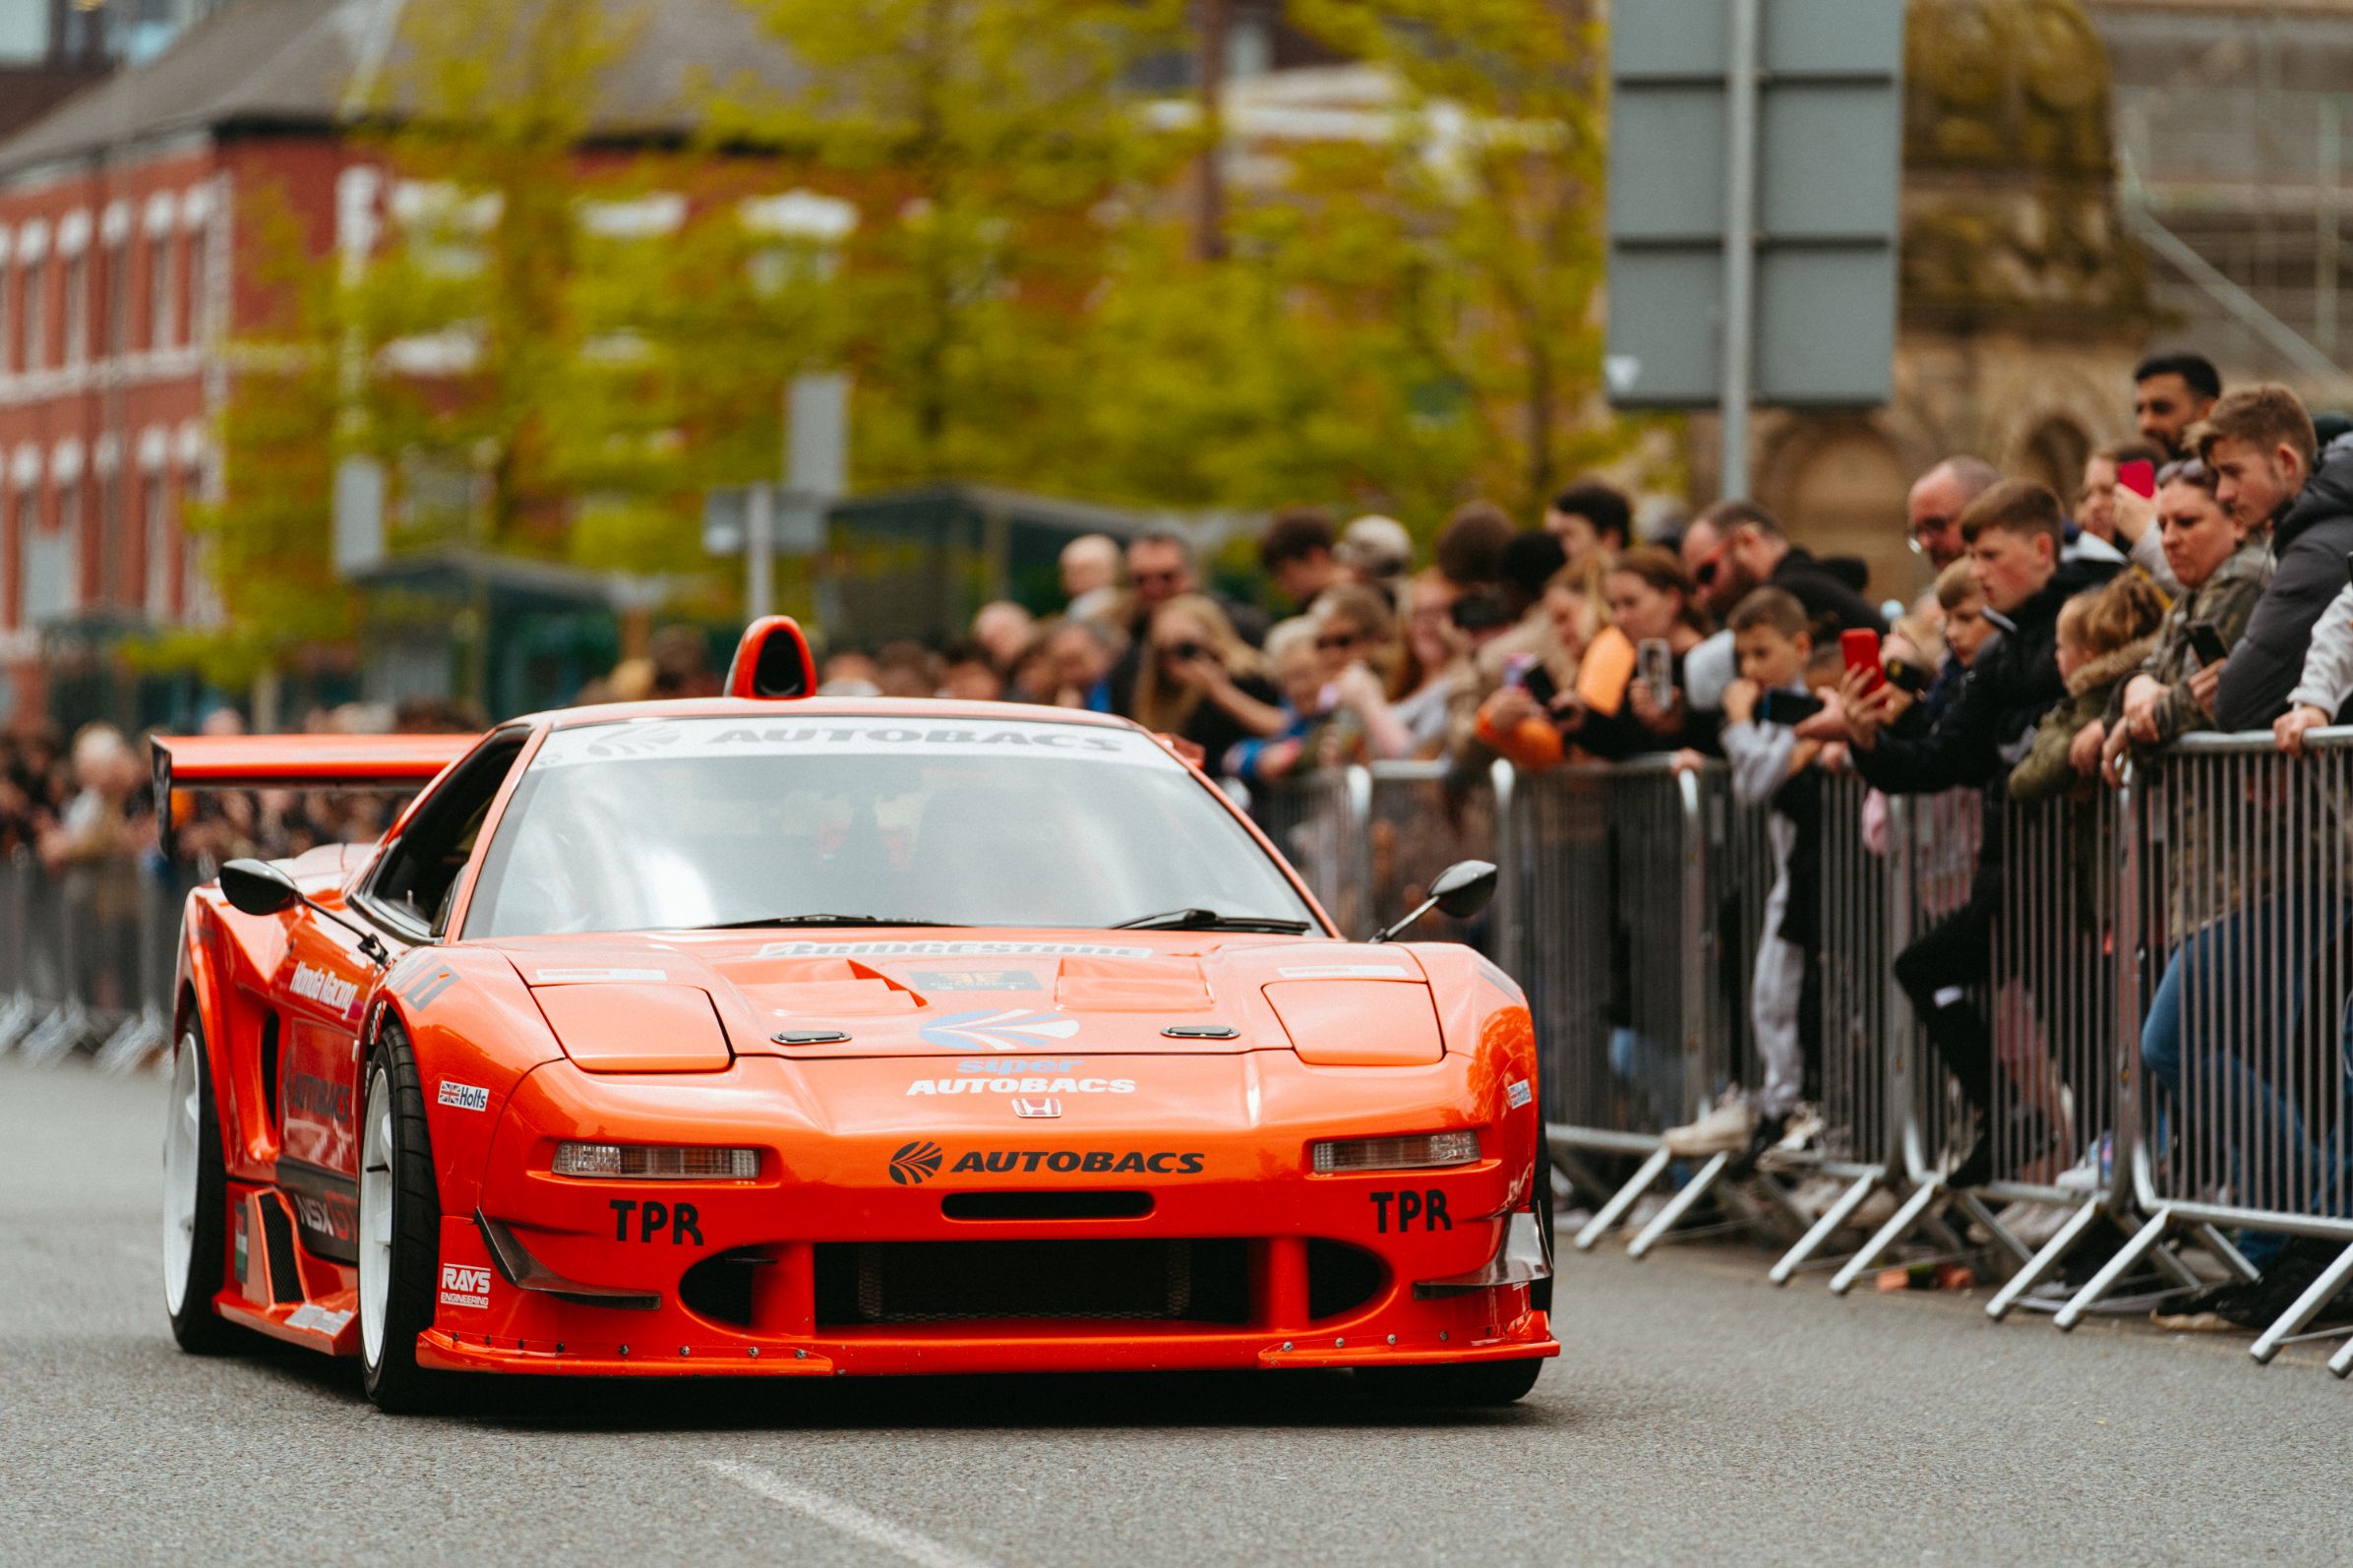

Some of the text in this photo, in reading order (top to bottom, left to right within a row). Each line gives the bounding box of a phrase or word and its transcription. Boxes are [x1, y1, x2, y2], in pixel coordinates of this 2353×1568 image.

[706, 728, 1122, 752] AUTOBACS
[956, 1058, 1085, 1075] super
[458, 1086, 486, 1110] Holts
[905, 1078, 1137, 1096] AUTOBACS
[949, 1151, 1205, 1174] AUTOBACS
[609, 1199, 704, 1246] TPR
[1369, 1188, 1452, 1234] TPR
[442, 1267, 491, 1294] RAYS
[441, 1292, 489, 1306] ENGINEERING
